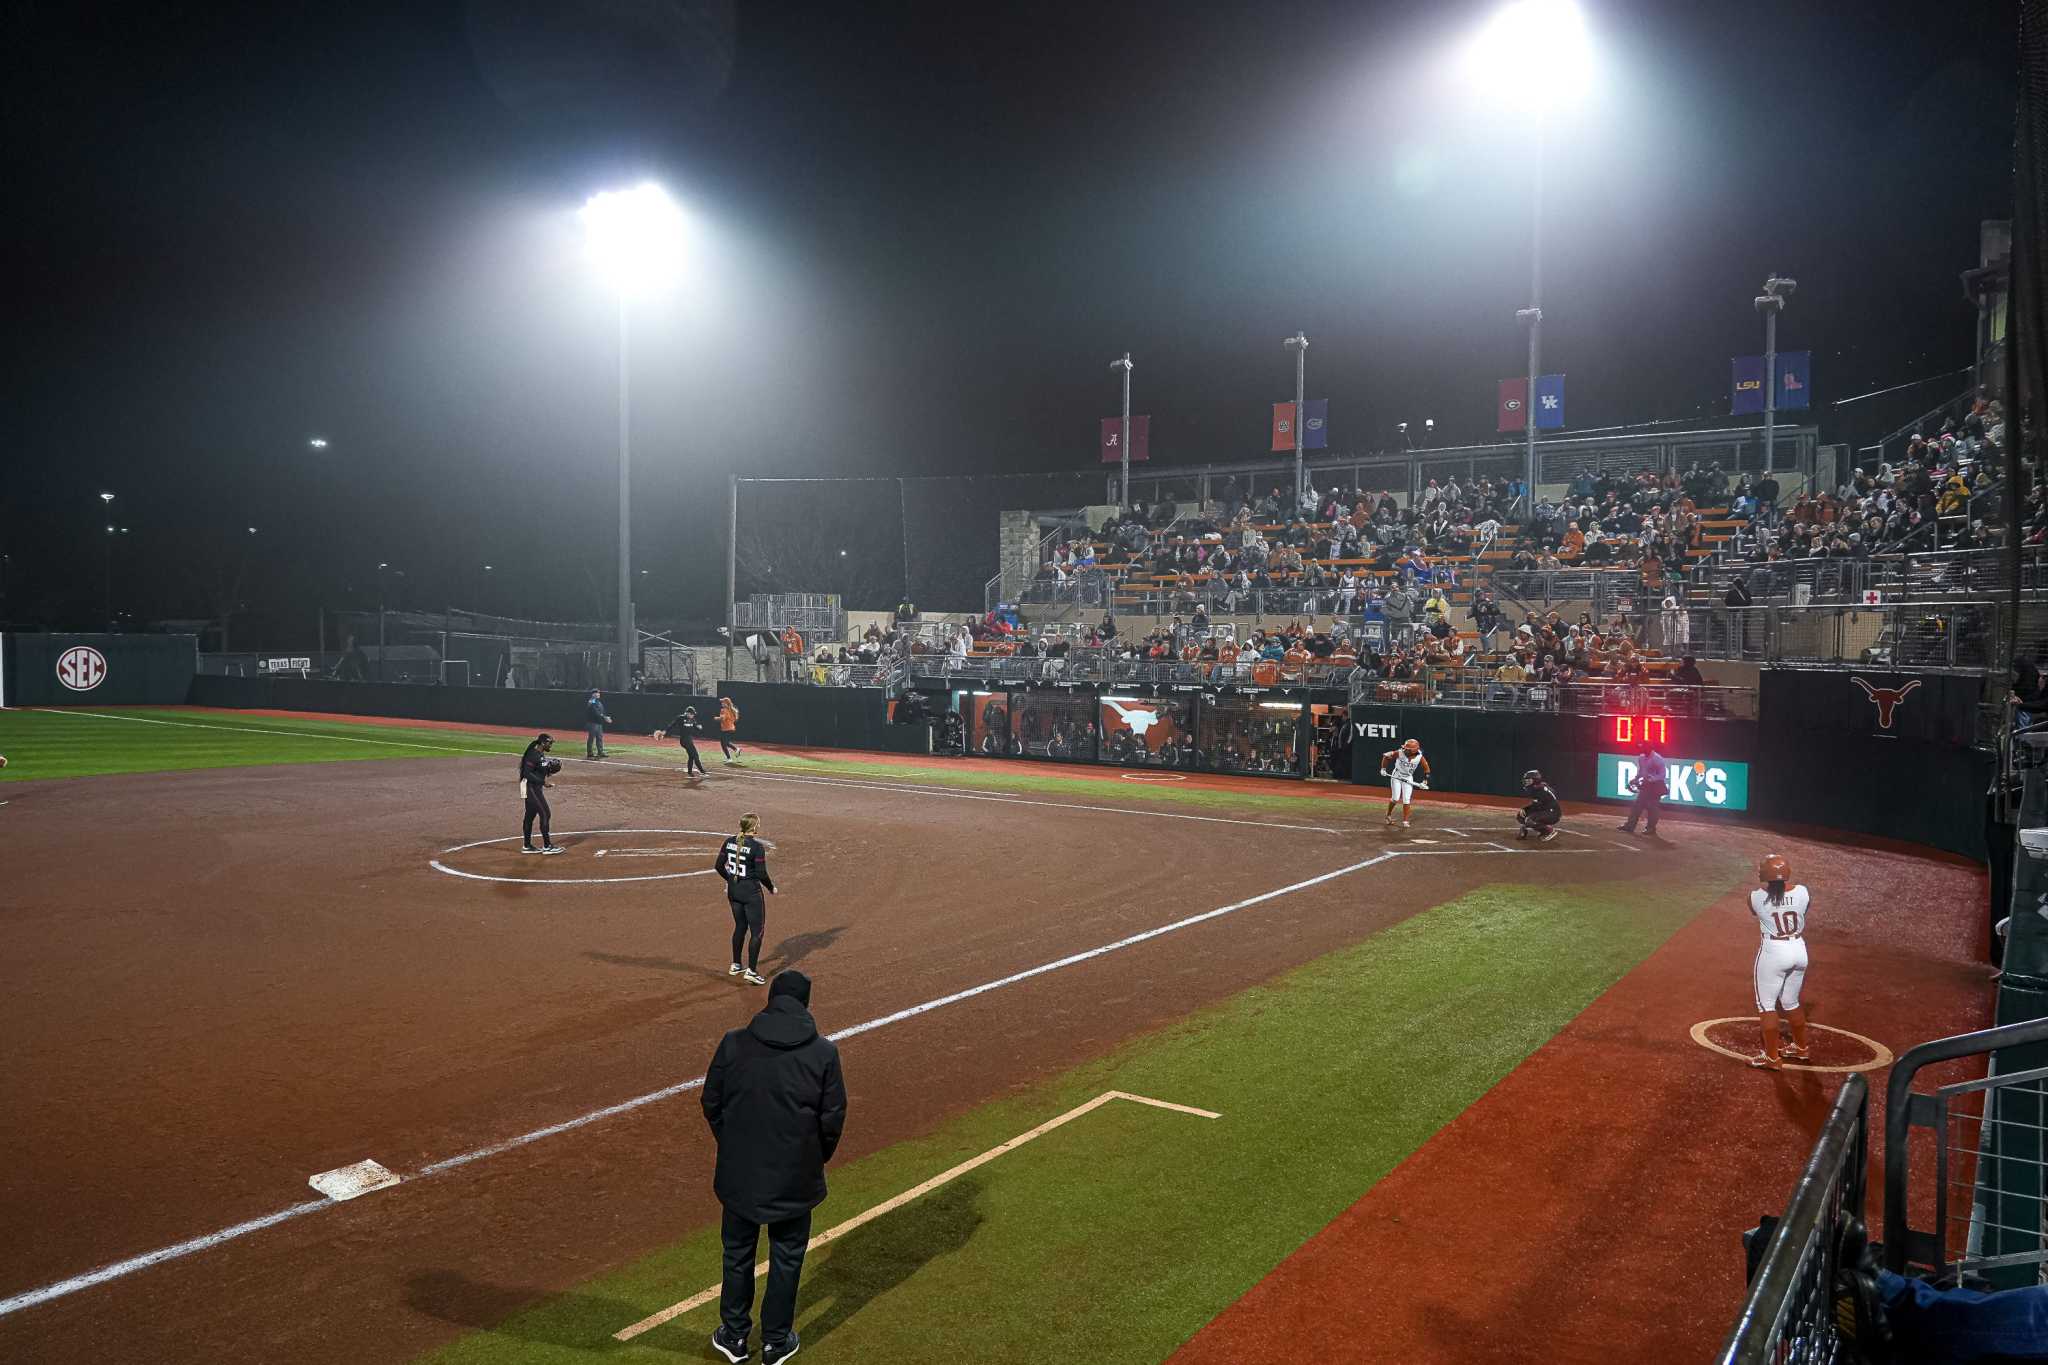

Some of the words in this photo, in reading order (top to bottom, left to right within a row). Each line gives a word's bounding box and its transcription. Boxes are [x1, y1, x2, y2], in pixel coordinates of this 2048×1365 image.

[1736, 380, 1760, 390] LSU
[60, 650, 102, 688] SEC
[1354, 722, 1396, 739] YETI
[1617, 760, 1728, 805] DK'S
[727, 852, 747, 877] 55
[1770, 910, 1798, 936] 10
